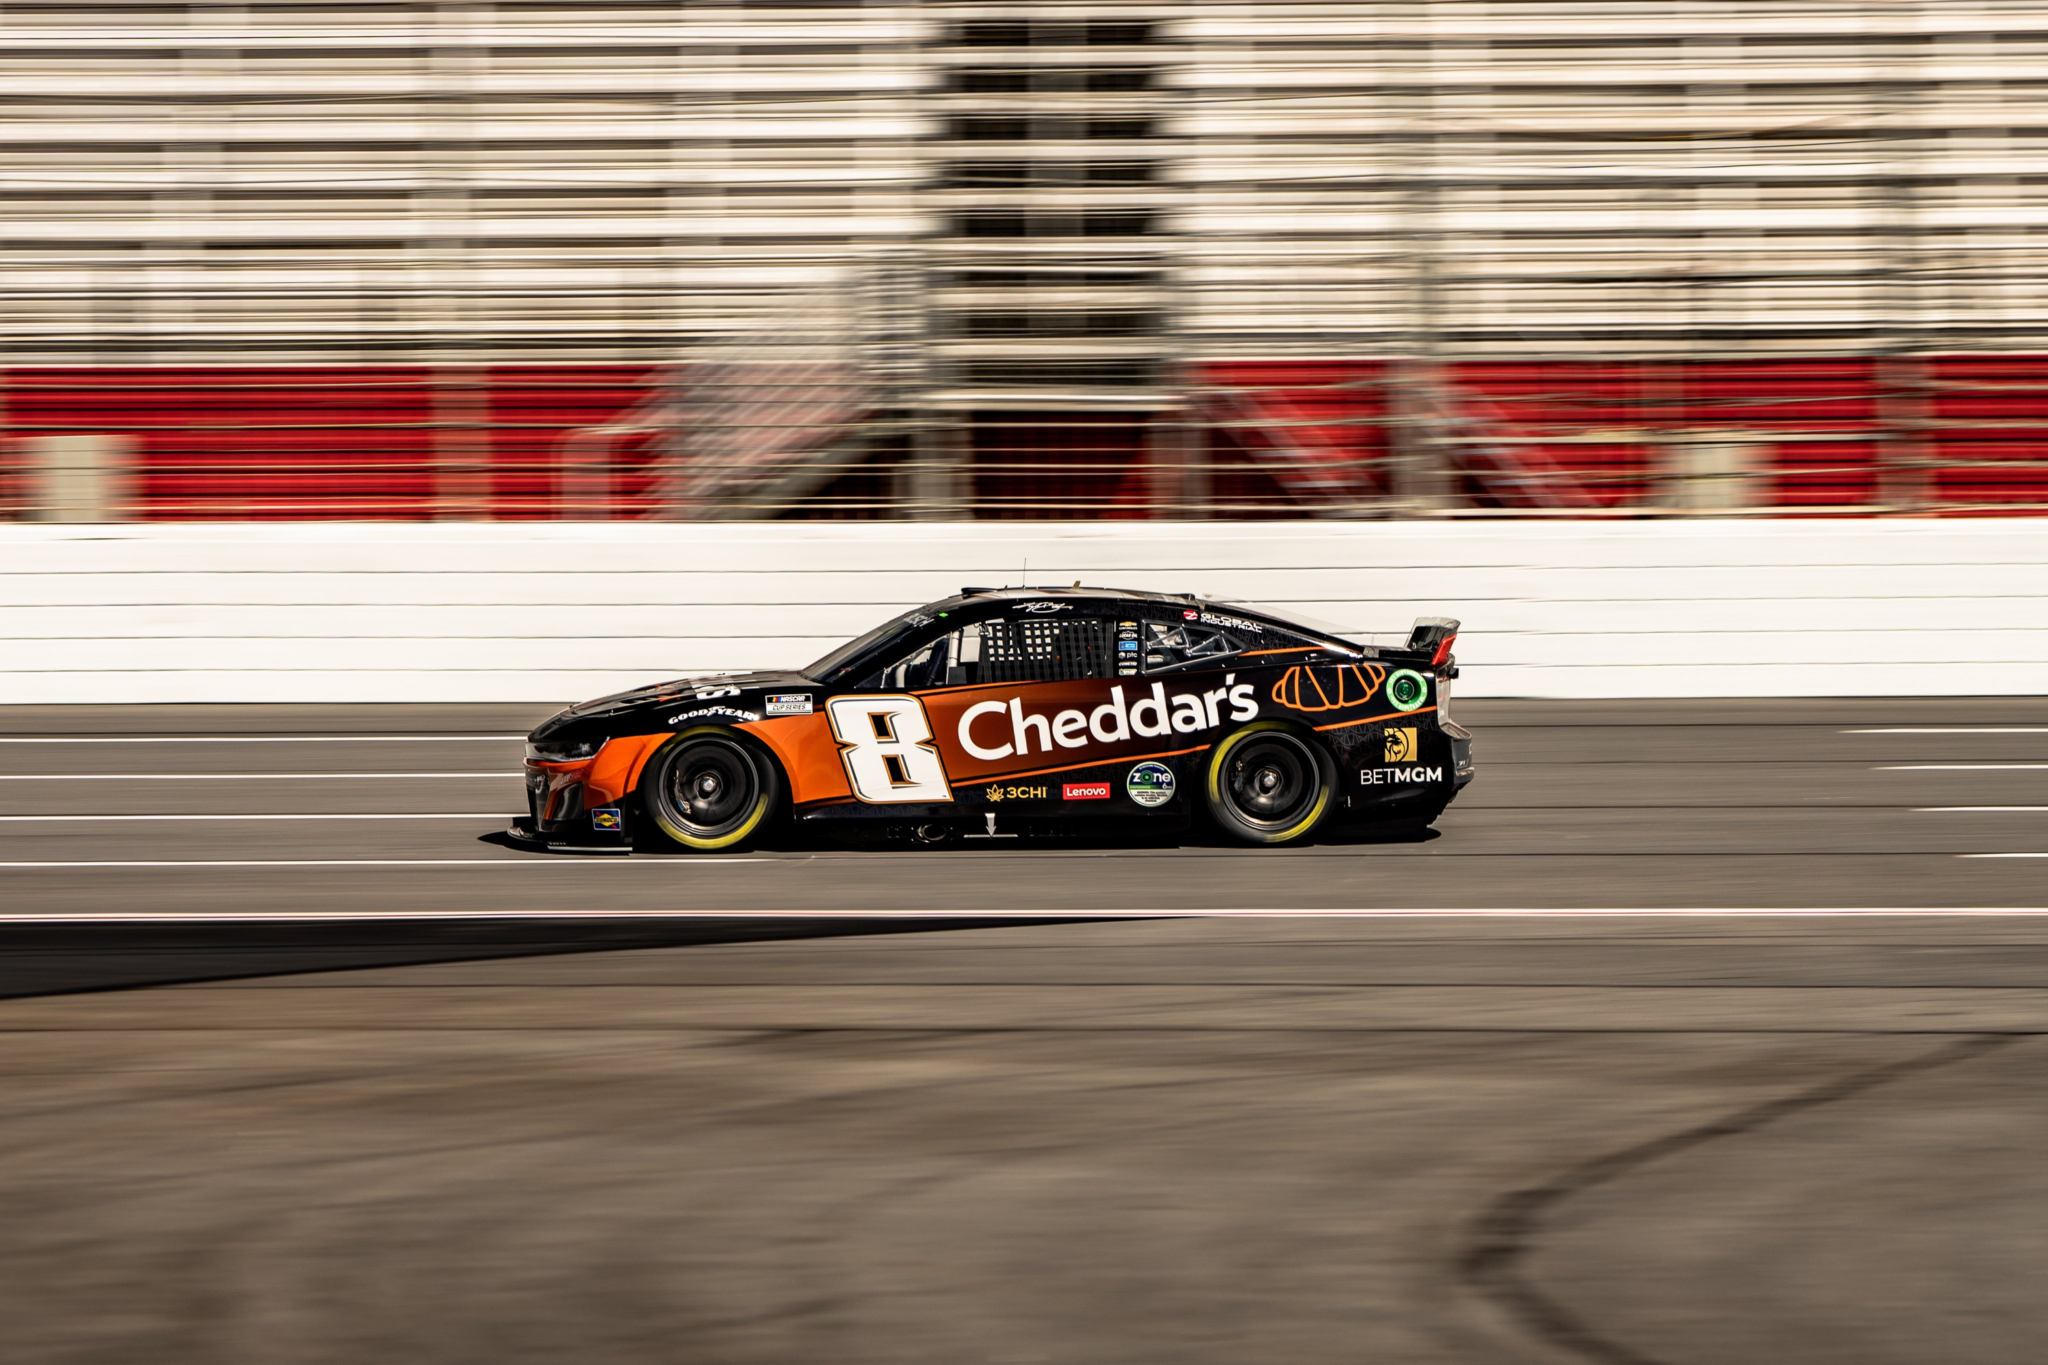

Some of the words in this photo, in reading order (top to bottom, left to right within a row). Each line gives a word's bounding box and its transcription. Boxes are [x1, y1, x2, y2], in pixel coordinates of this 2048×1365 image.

[1200, 612, 1262, 628] GLOBAL
[1200, 617, 1263, 633] INDUSTRIAL
[780, 695, 806, 703] NASCAR
[785, 703, 806, 711] SERIES
[668, 706, 760, 725] GOODYEAR
[958, 673, 1259, 760] Cheddar's
[825, 694, 954, 804] 8
[1360, 766, 1443, 785] BETMGM
[1006, 786, 1046, 799] 3CHI
[1066, 786, 1106, 797] Lenovo
